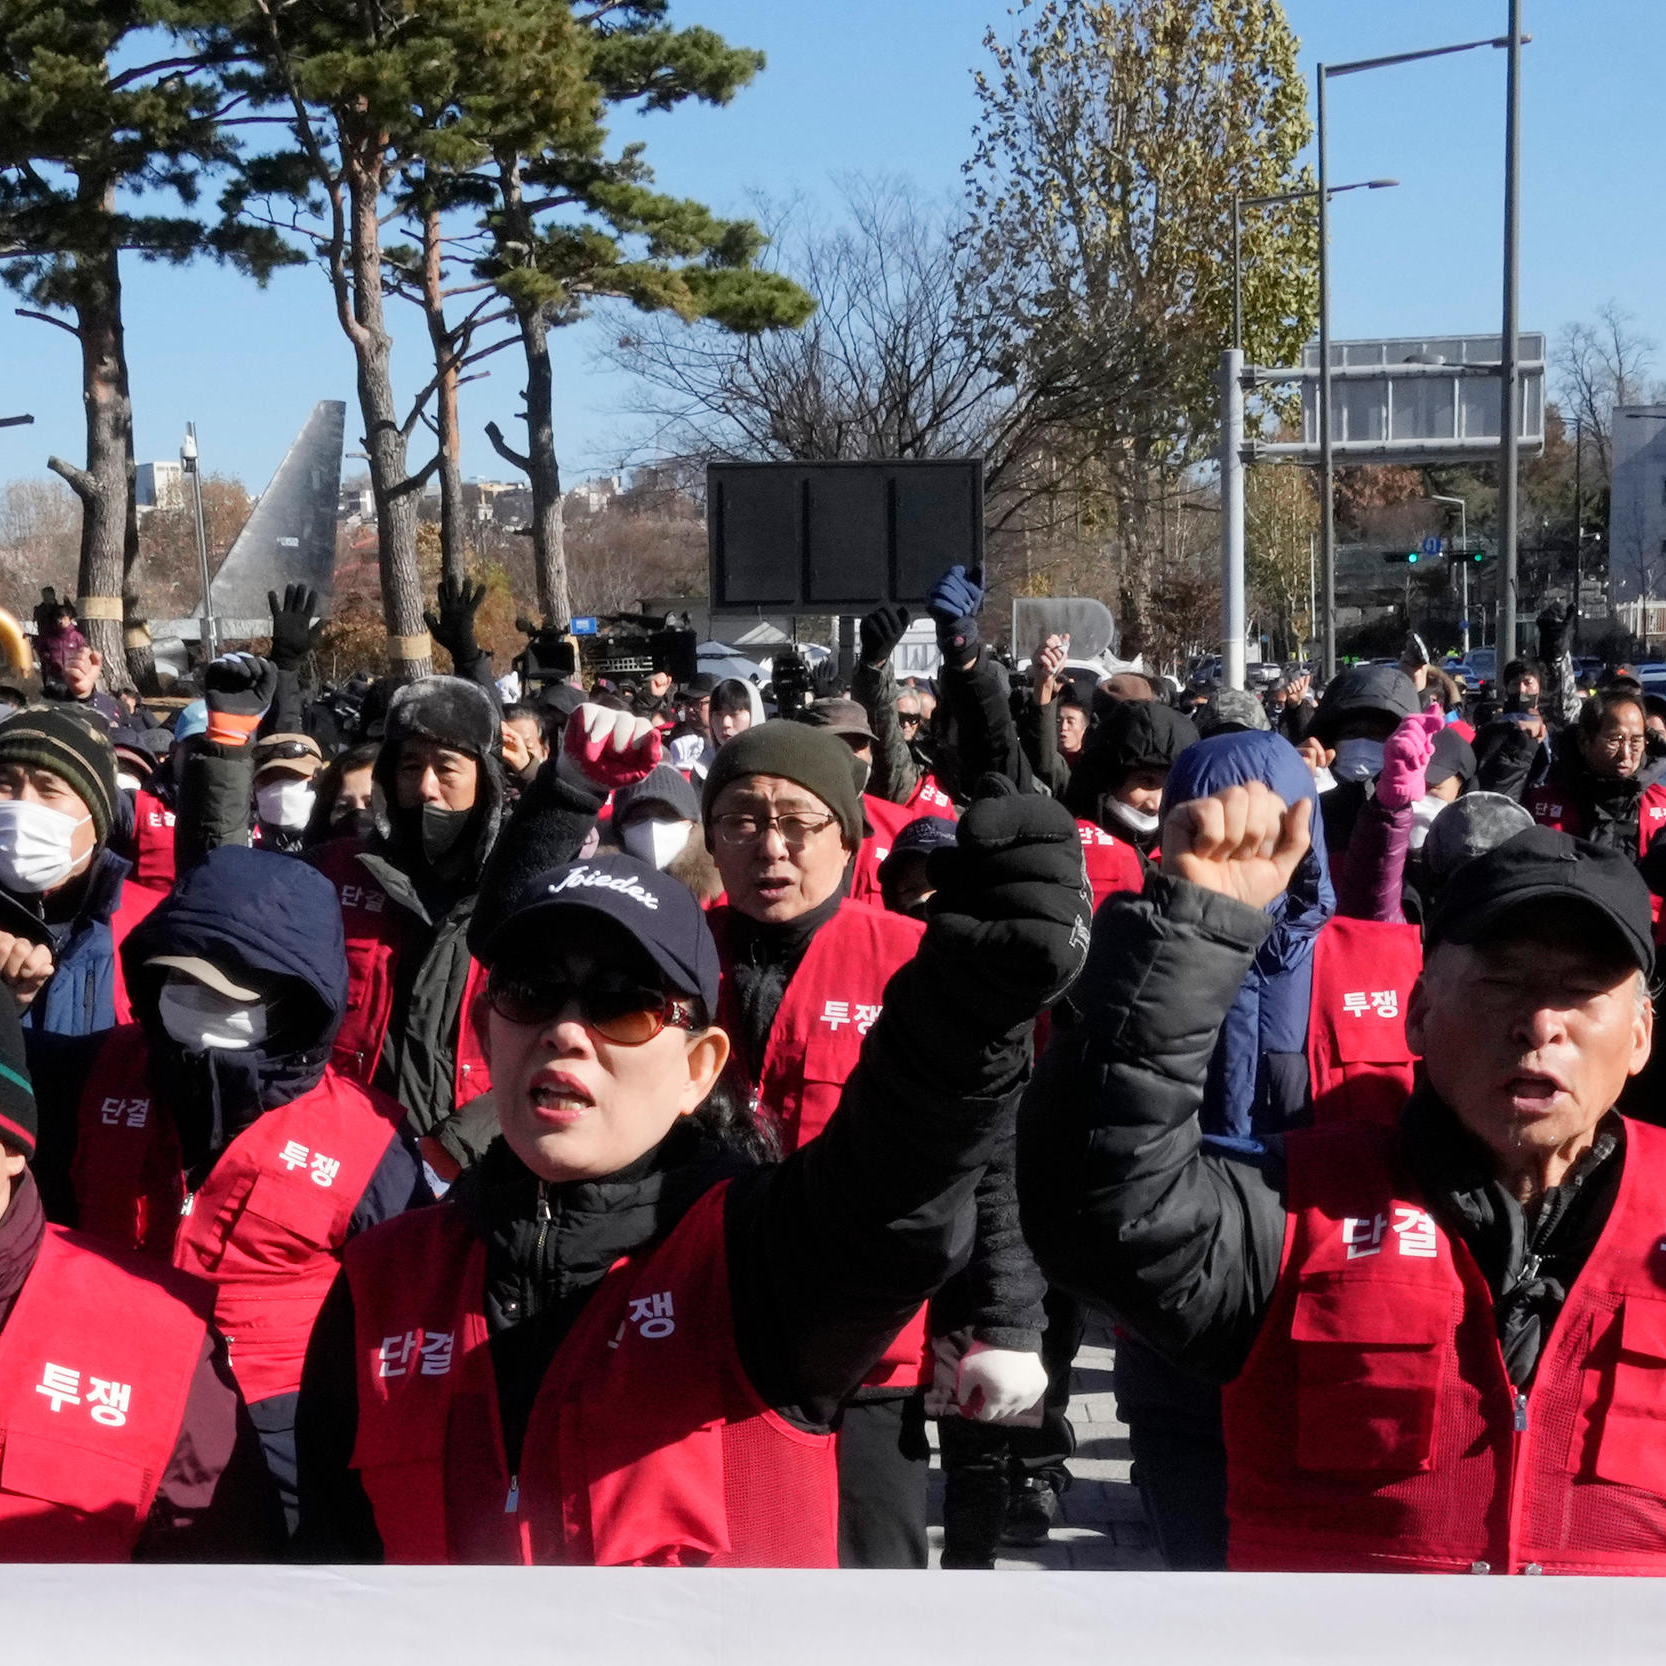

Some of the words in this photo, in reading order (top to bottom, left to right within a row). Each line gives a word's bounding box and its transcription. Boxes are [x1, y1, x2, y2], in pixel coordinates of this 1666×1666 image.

[341, 885, 383, 912] 단결
[548, 866, 659, 910] Joiedex
[1343, 990, 1399, 1019] 투쟁
[102, 1098, 150, 1127] 단결
[279, 1140, 341, 1188] 투쟁
[1342, 1208, 1439, 1260] 단결
[608, 1291, 676, 1349] 쟁
[378, 1330, 455, 1377] 단결
[36, 1362, 132, 1427] 투쟁
